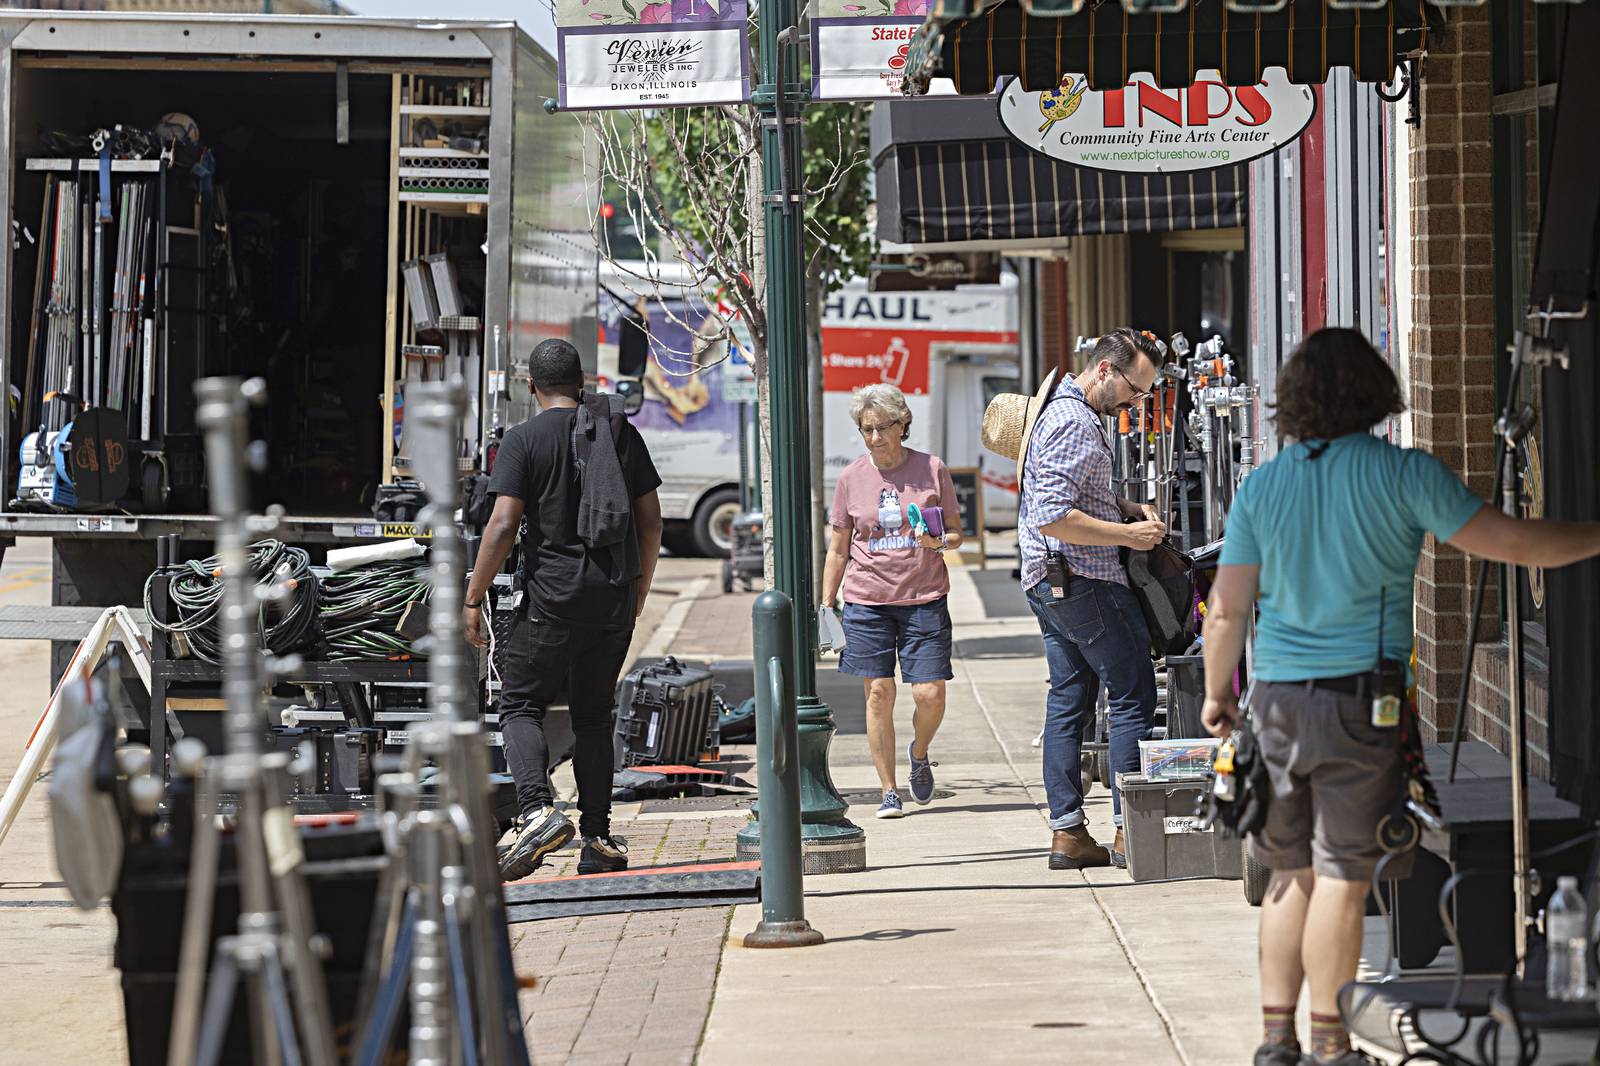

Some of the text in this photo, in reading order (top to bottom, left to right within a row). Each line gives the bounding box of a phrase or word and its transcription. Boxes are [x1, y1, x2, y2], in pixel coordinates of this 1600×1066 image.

[607, 39, 692, 63] Venier
[612, 63, 675, 73] JEWELERS
[1059, 128, 1270, 147] Community Fine Arts Center
[1080, 148, 1230, 162] www.nextpictureshow.org
